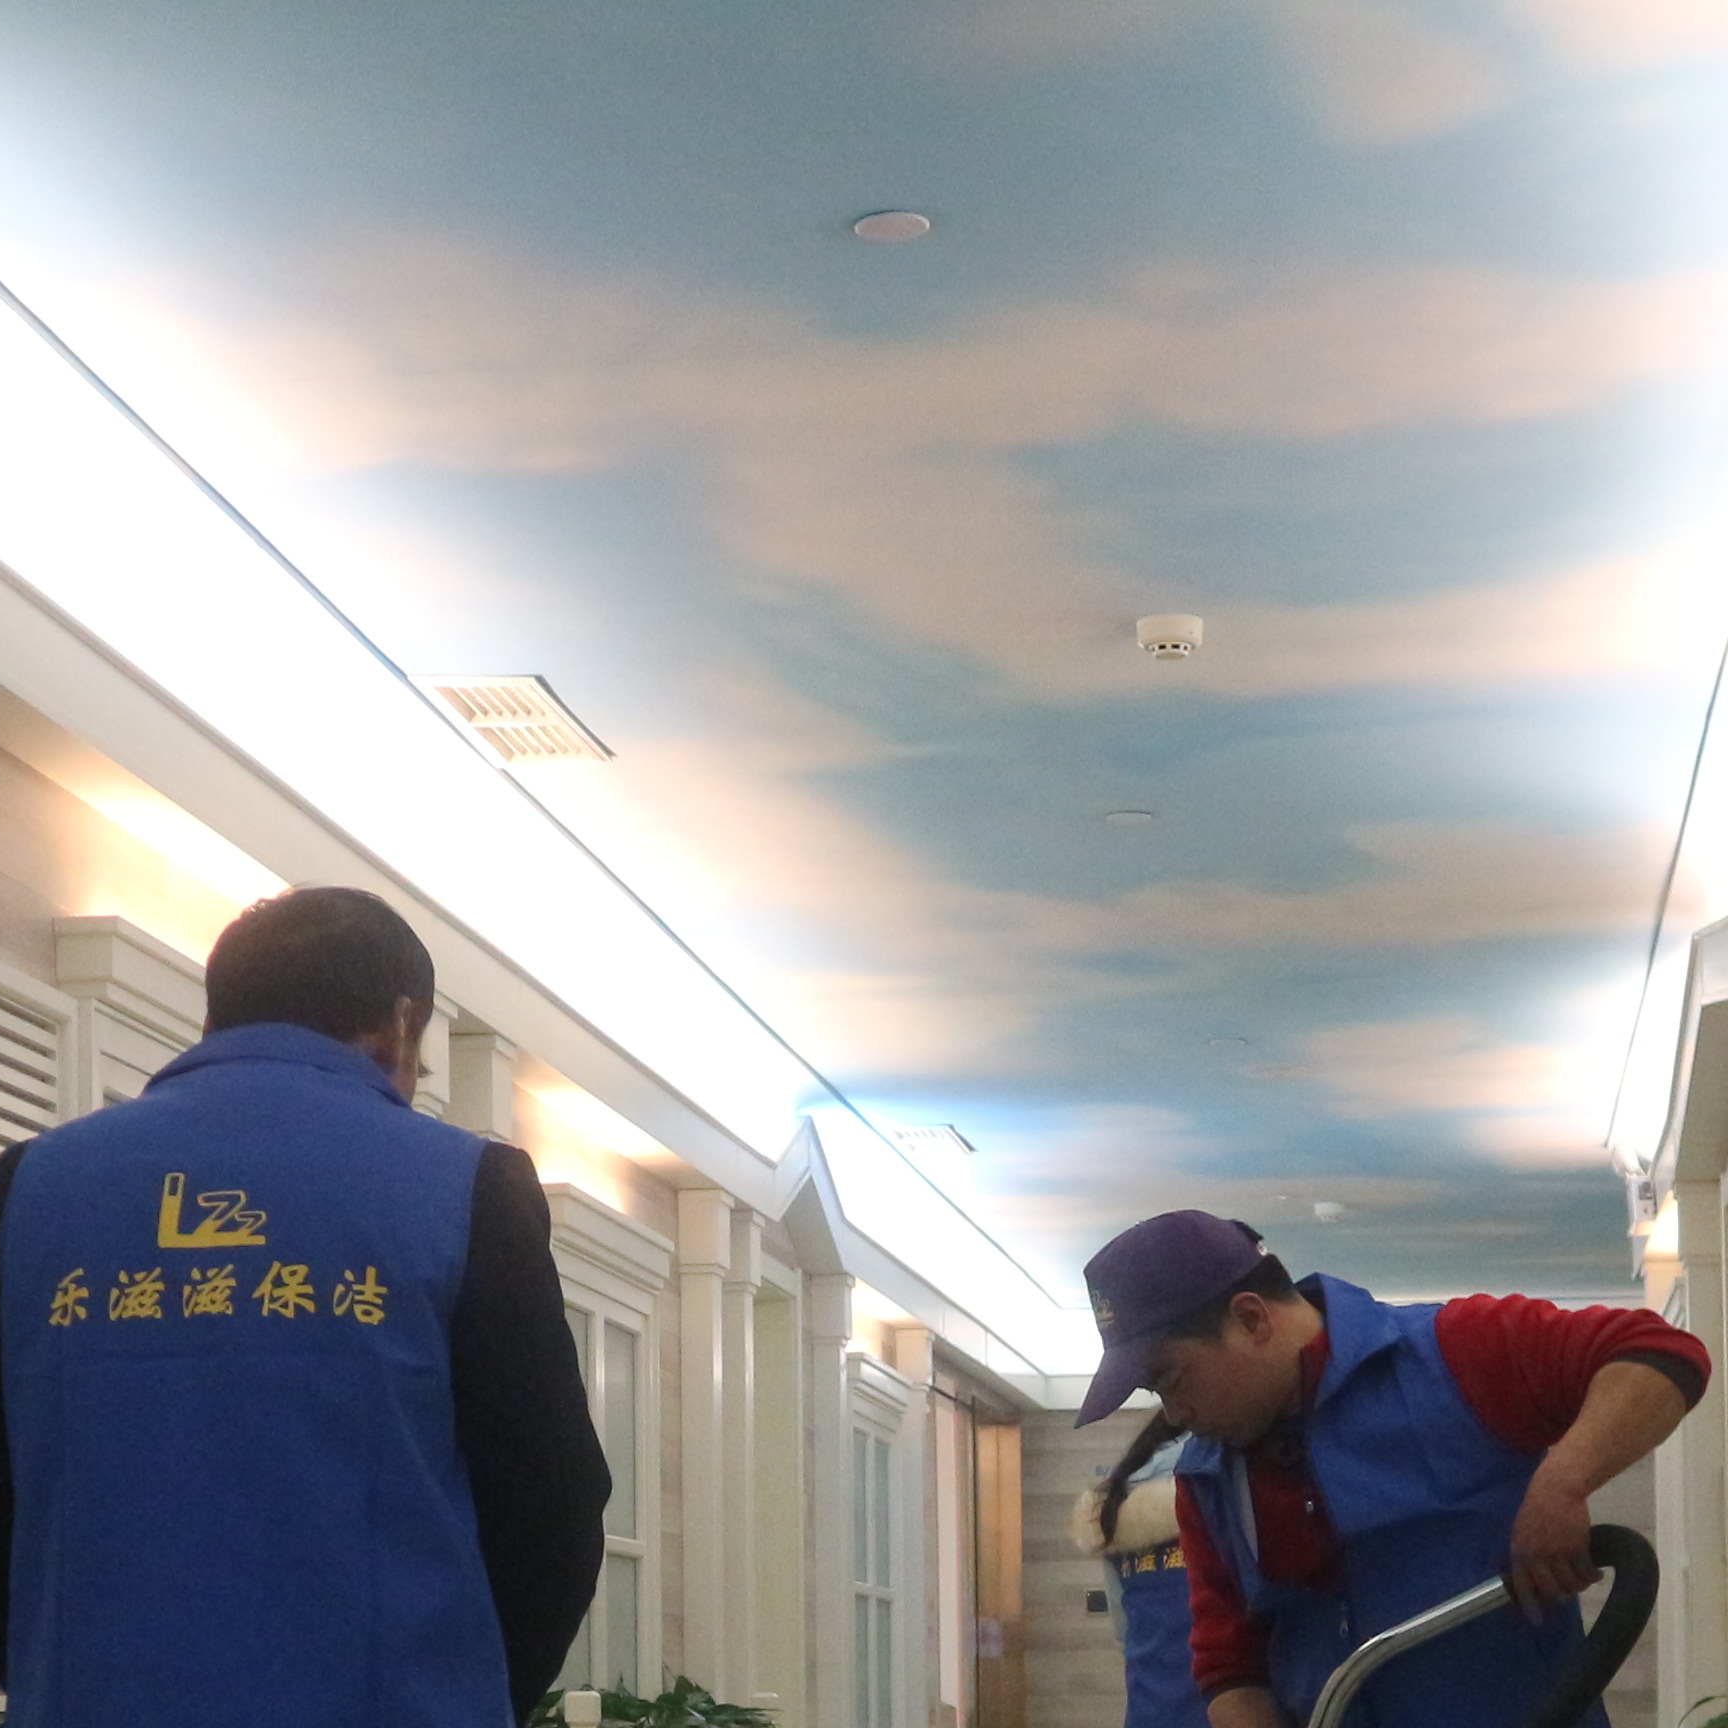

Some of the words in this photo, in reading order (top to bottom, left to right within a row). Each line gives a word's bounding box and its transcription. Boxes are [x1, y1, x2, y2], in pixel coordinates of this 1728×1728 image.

[49, 1261, 389, 1326] 乐滋滋保洁
